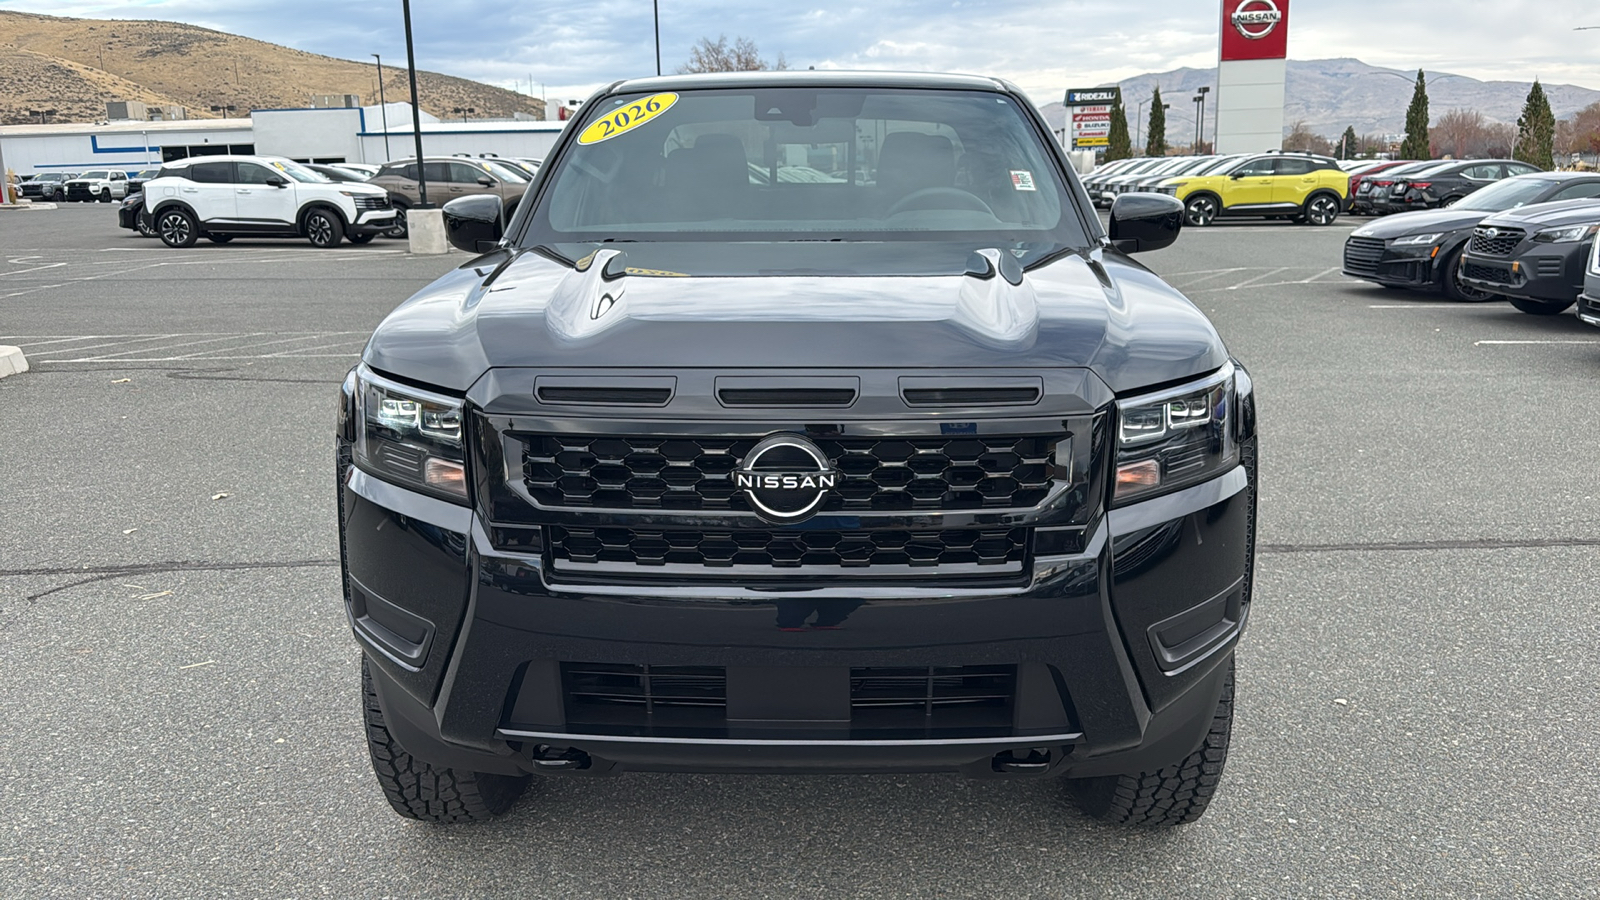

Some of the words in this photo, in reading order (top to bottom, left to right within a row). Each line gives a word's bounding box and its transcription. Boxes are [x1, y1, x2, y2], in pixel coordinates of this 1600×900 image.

[1236, 13, 1277, 21] NISSAN
[597, 97, 661, 137] 2026
[737, 474, 835, 489] NISSAN
